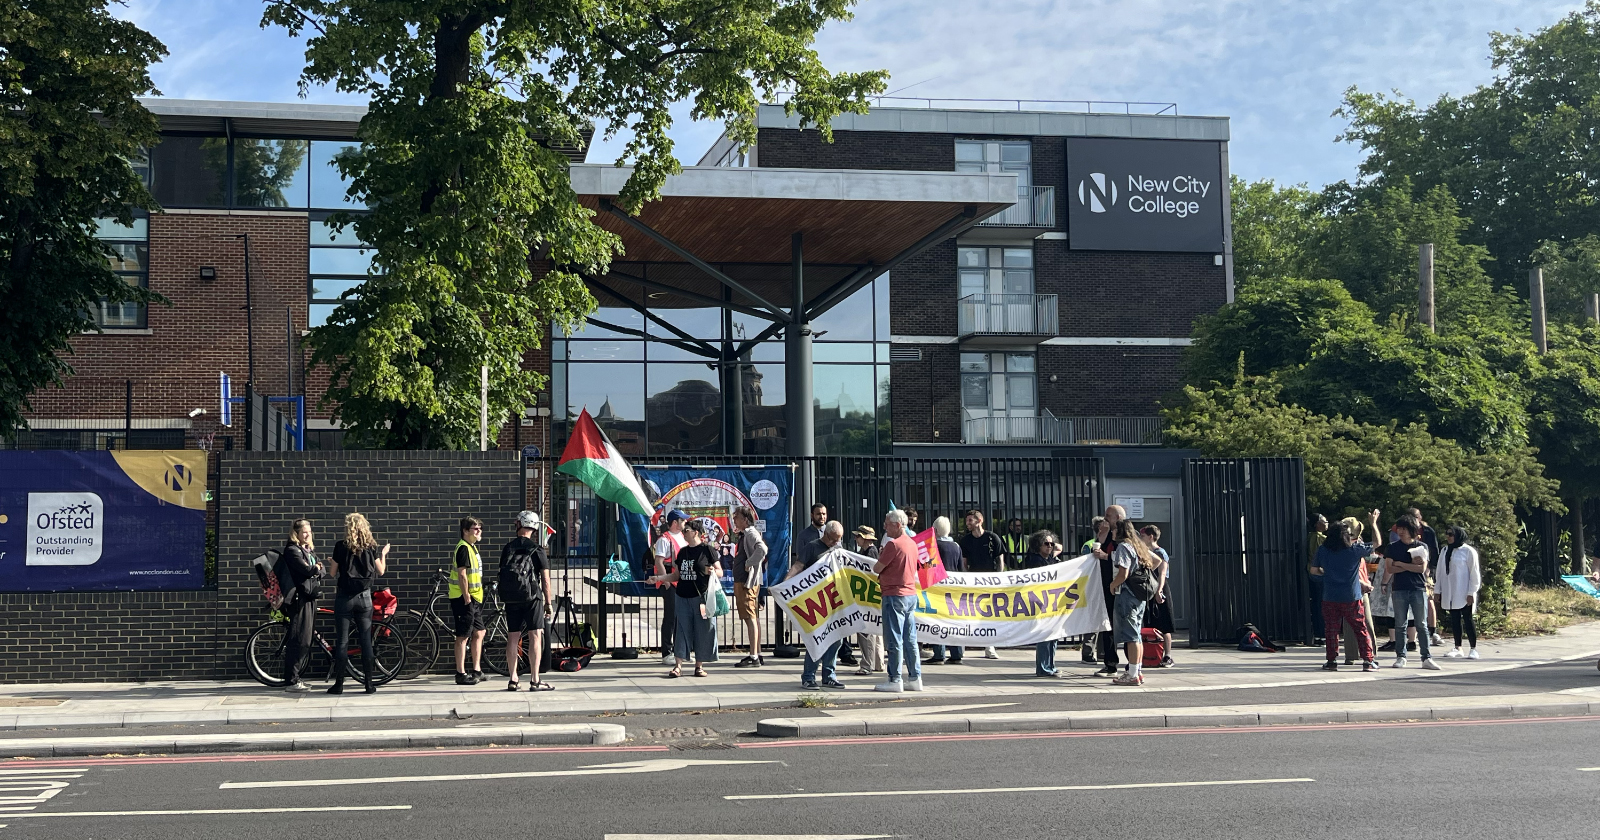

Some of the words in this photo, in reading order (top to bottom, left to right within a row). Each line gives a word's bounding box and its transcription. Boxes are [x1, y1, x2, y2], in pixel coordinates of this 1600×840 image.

[1128, 174, 1169, 193] New
[1172, 175, 1210, 198] City
[1128, 195, 1200, 218] College
[36, 512, 94, 529] Ofsted
[36, 536, 94, 546] Outstanding
[36, 546, 75, 555] Provider
[780, 565, 834, 600] HACKNEY
[974, 576, 1001, 586] AND
[1009, 570, 1058, 585] FASCISM
[791, 581, 844, 626] WE
[945, 583, 1080, 618] MIGRANTS
